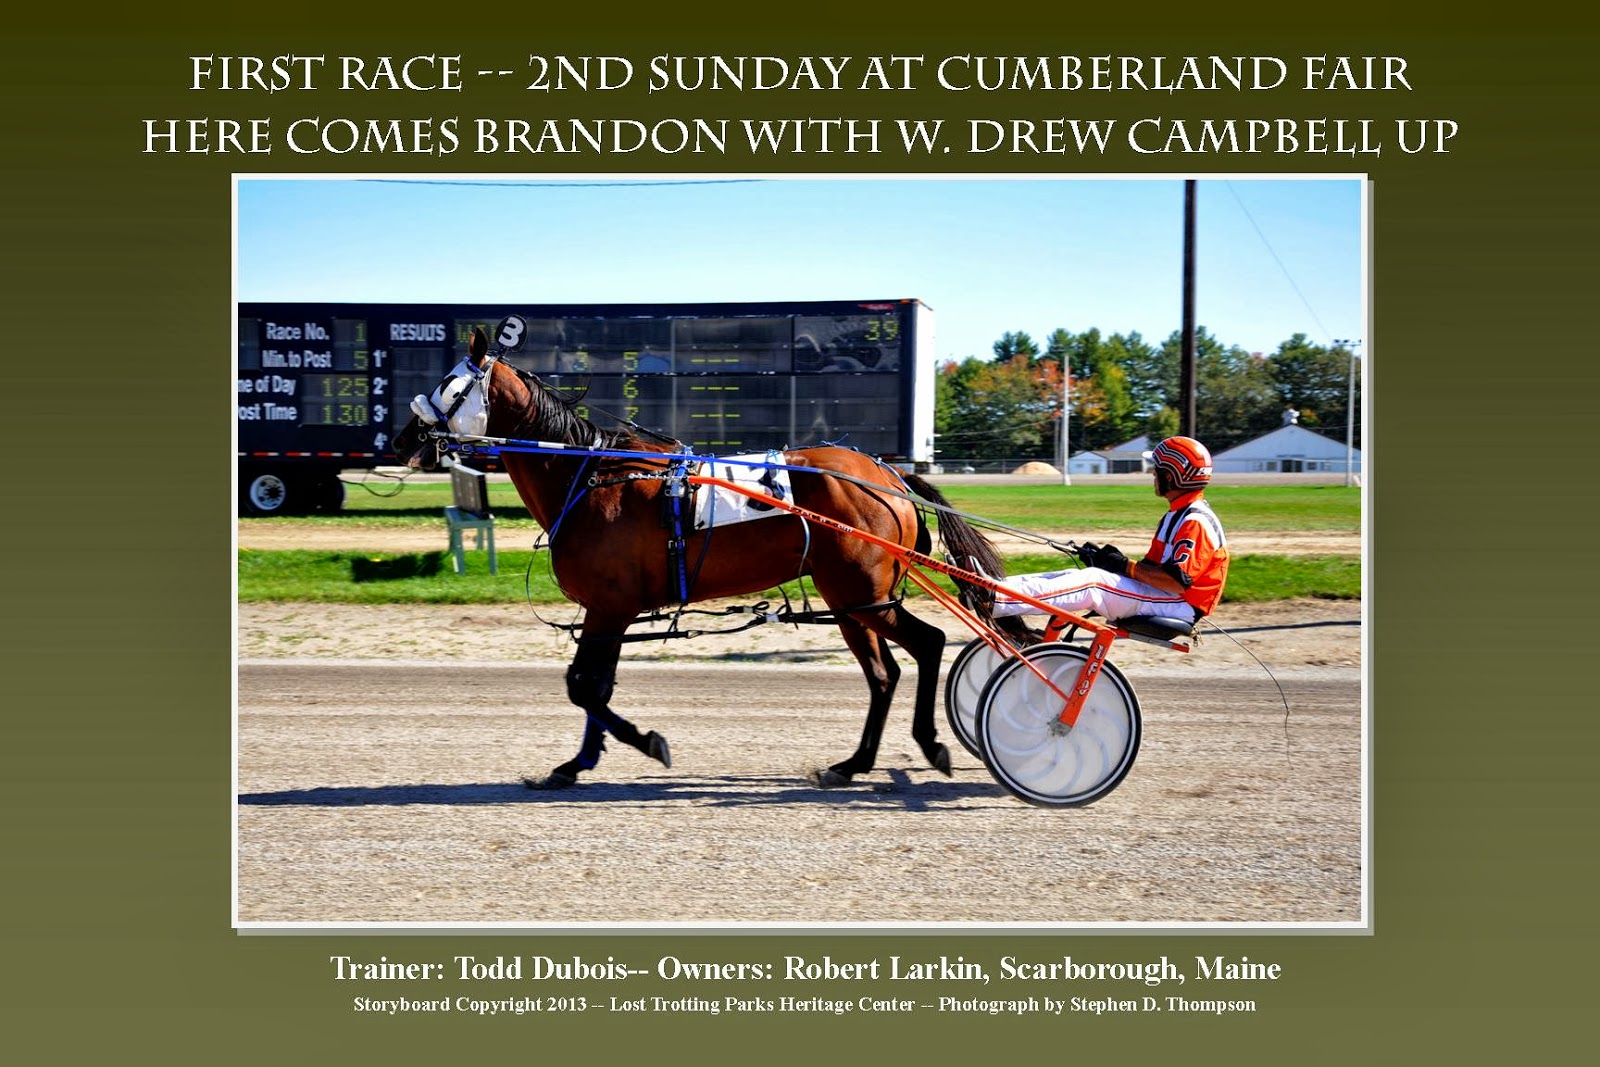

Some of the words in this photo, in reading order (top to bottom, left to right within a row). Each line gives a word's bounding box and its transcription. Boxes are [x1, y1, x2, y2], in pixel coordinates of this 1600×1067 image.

[266, 322, 302, 340] Race
[304, 322, 330, 340] No.
[390, 323, 447, 341] RESULTS
[498, 316, 524, 347] 3
[864, 320, 898, 341] 39
[303, 350, 332, 368] Post
[354, 350, 369, 369] 5
[623, 352, 639, 371] 5
[254, 375, 270, 393] of
[271, 375, 296, 396] Day
[623, 379, 639, 398] 6
[238, 403, 261, 420] ost
[263, 402, 298, 420] Time
[1171, 538, 1196, 565] C
